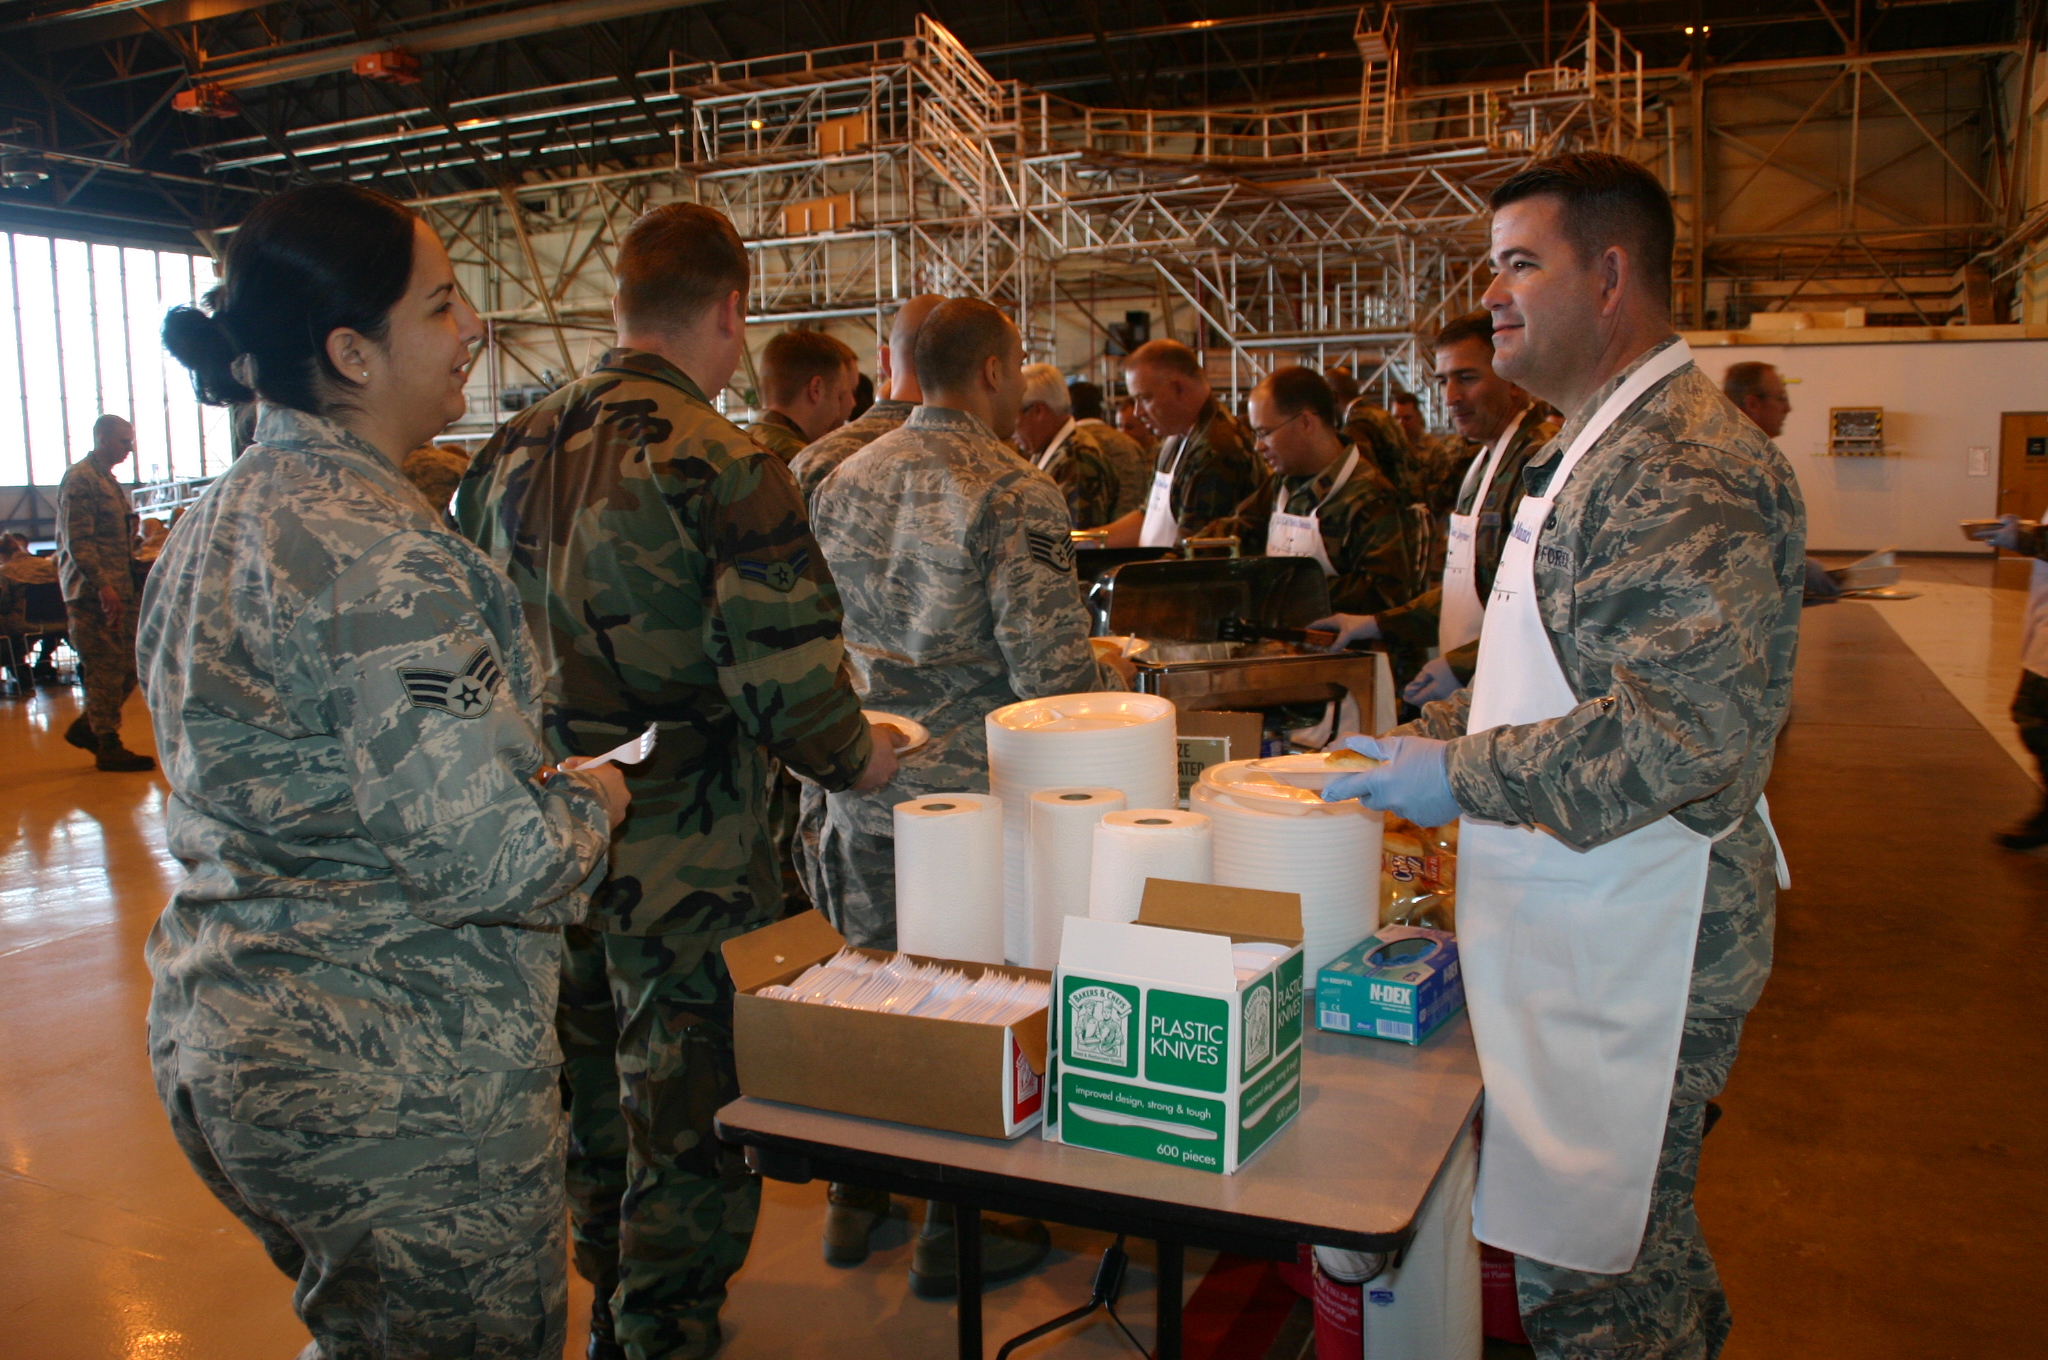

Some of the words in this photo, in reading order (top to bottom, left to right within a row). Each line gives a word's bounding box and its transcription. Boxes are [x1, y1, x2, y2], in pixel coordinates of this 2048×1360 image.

[1073, 989, 1099, 1003] BAKERS
[1100, 989, 1105, 998] &
[1370, 983, 1411, 1006] N-DEX
[1151, 1015, 1224, 1045] PLASTIC
[1150, 1036, 1219, 1066] KNIVES
[1075, 1085, 1114, 1101] improved
[1115, 1092, 1145, 1109] design,
[1147, 1100, 1174, 1115] strong
[1176, 1104, 1184, 1115] &
[1186, 1107, 1212, 1121] tough
[1156, 1143, 1179, 1158] 600
[1182, 1149, 1217, 1166] pieces
